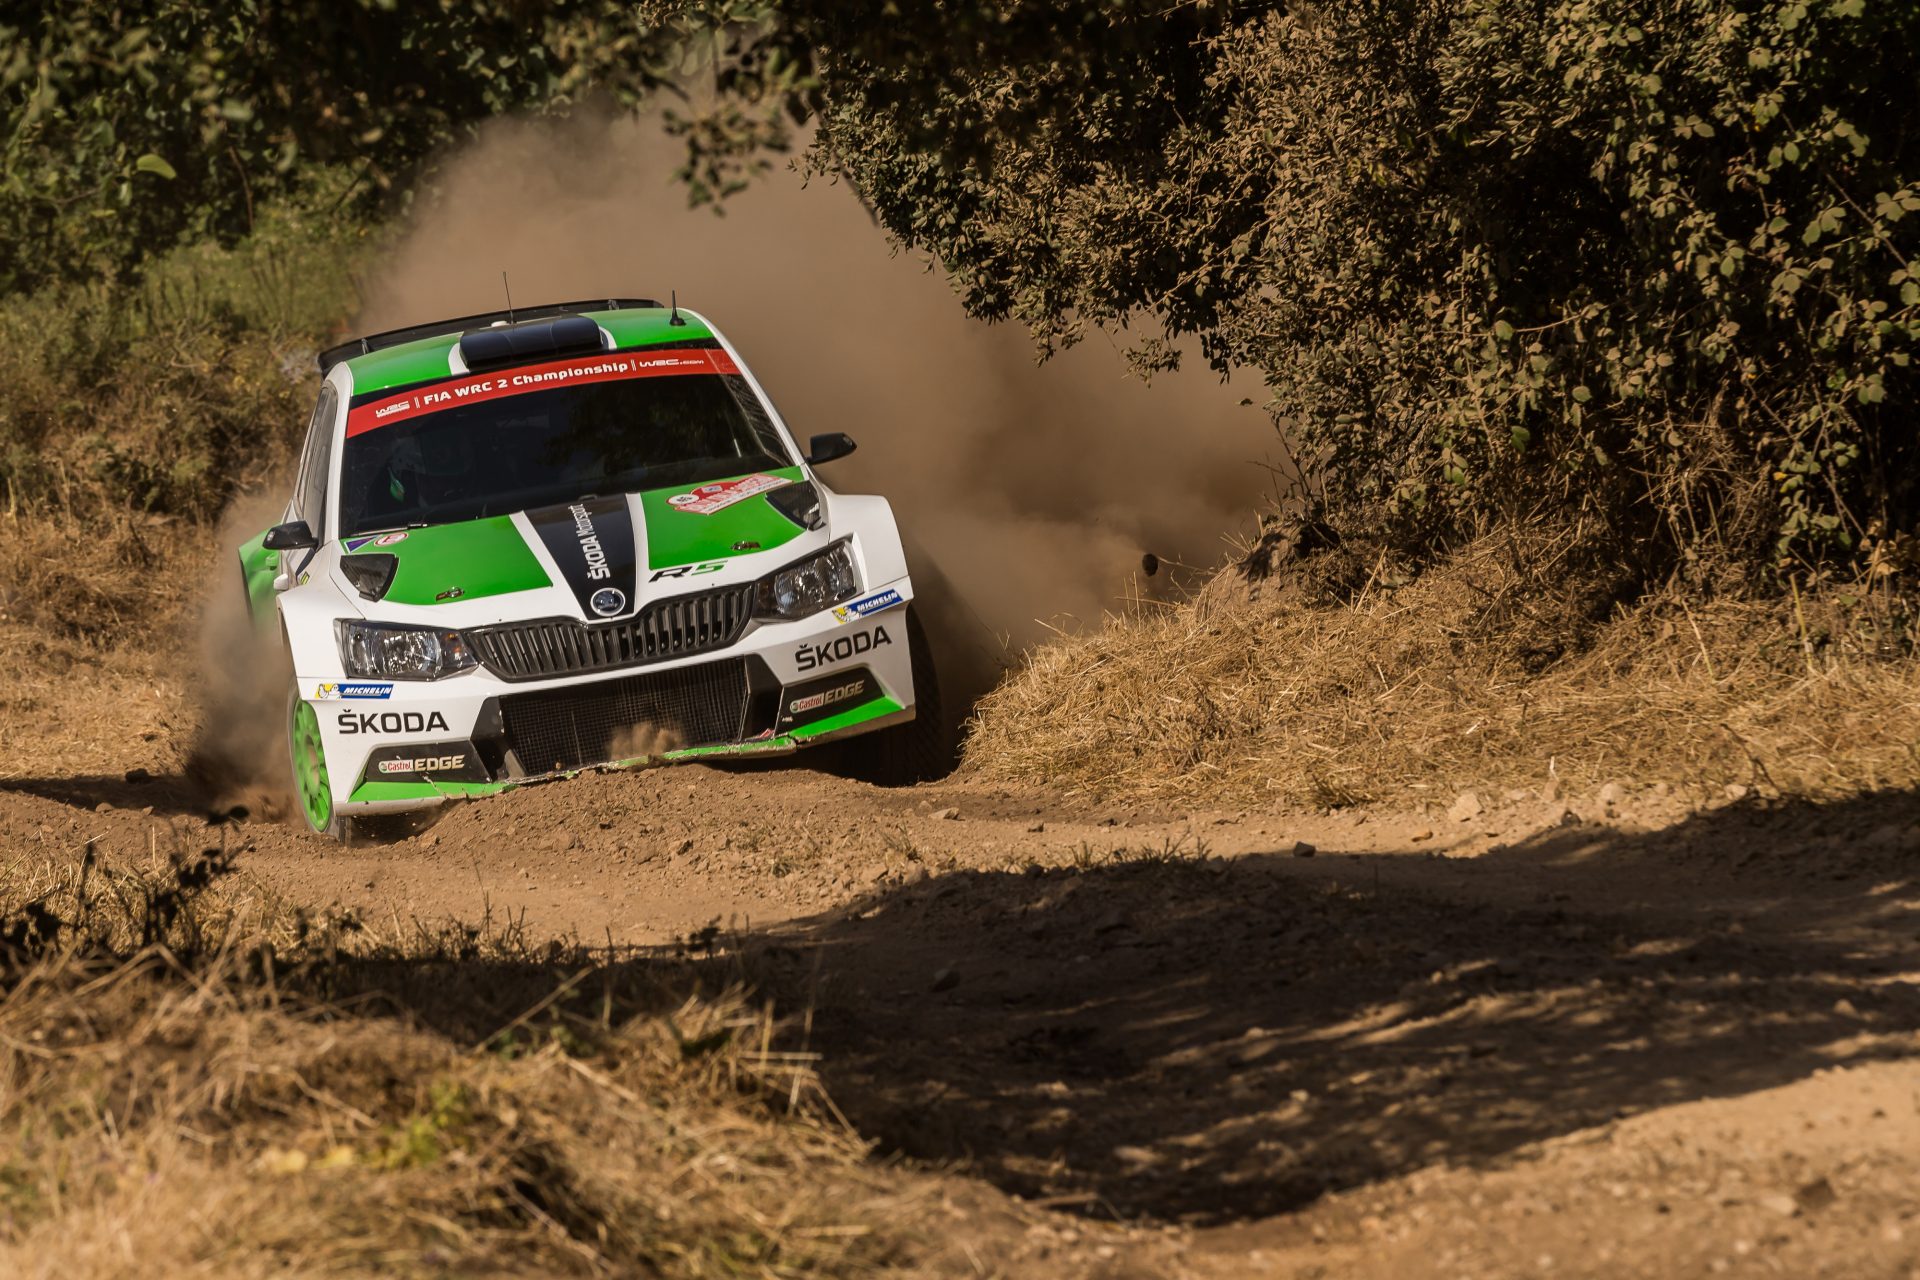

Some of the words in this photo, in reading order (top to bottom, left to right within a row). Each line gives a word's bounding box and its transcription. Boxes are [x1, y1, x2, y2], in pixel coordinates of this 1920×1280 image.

[424, 391, 452, 406] FIA
[454, 381, 493, 398] WRC
[497, 378, 508, 389] 2
[512, 362, 629, 385] Championship
[580, 535, 612, 581] ŠKODA
[648, 560, 729, 583] R5
[857, 592, 899, 612] MICHELIN
[794, 625, 893, 673] ŠKODA
[343, 686, 392, 696] MICHELIN
[799, 694, 824, 710] Castrol
[824, 680, 865, 704] EDGE
[338, 708, 450, 735] ŠKODA
[387, 760, 412, 772] Castrol
[414, 754, 466, 772] EDGE
